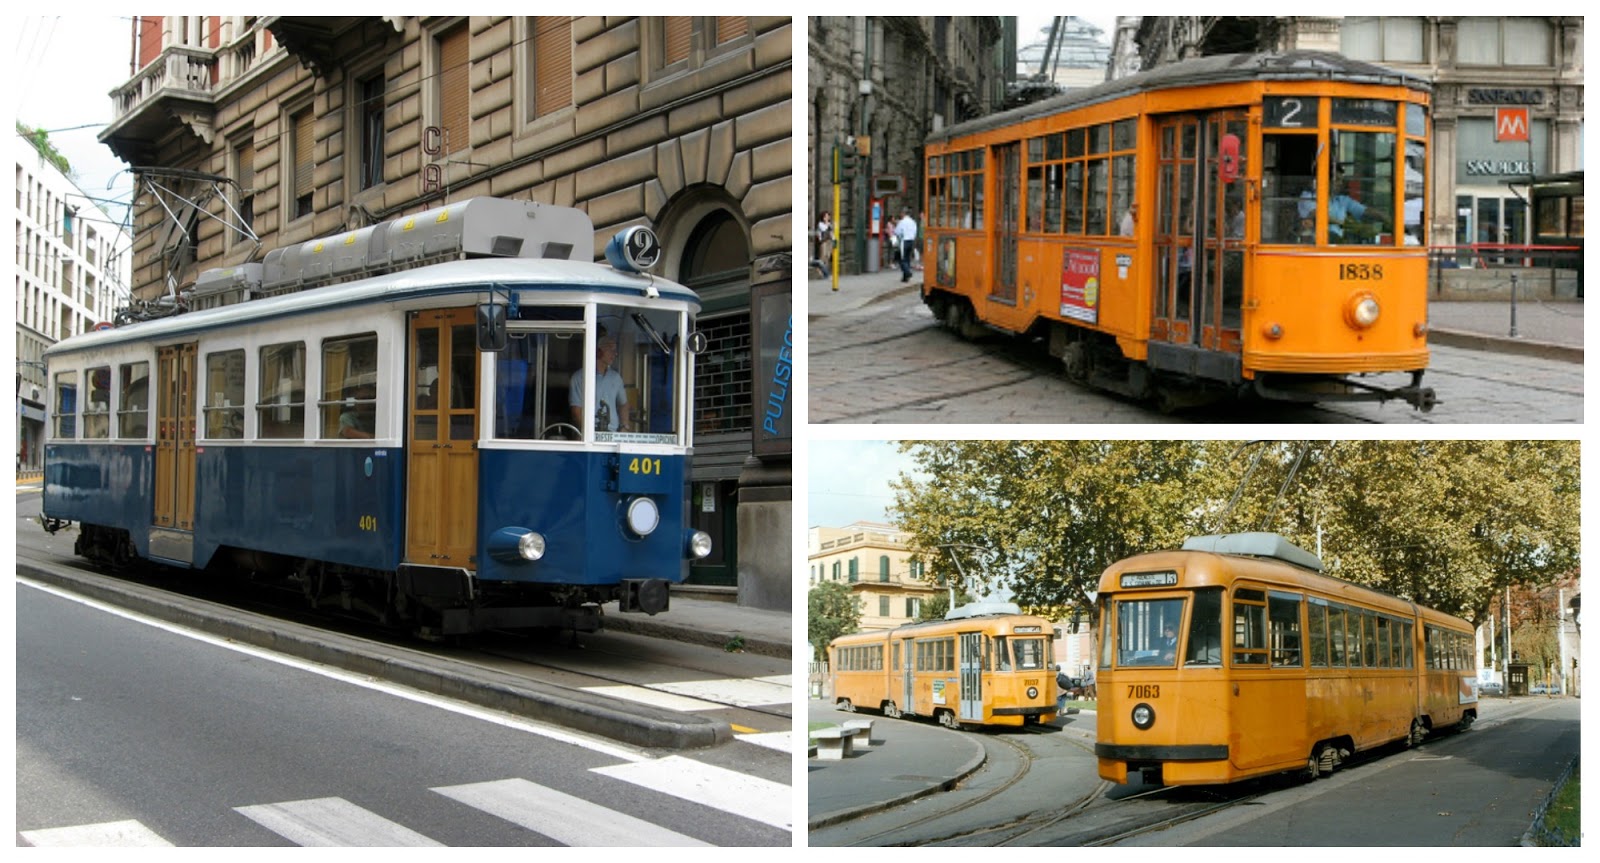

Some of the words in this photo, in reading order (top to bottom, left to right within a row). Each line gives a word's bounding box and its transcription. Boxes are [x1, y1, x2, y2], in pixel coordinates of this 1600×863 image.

[1281, 98, 1302, 126] 2
[1499, 115, 1526, 135] M
[634, 230, 654, 264] 2
[694, 334, 700, 352] 1
[628, 457, 661, 475] 401
[359, 515, 377, 532] 401
[1127, 684, 1160, 699] 7063
